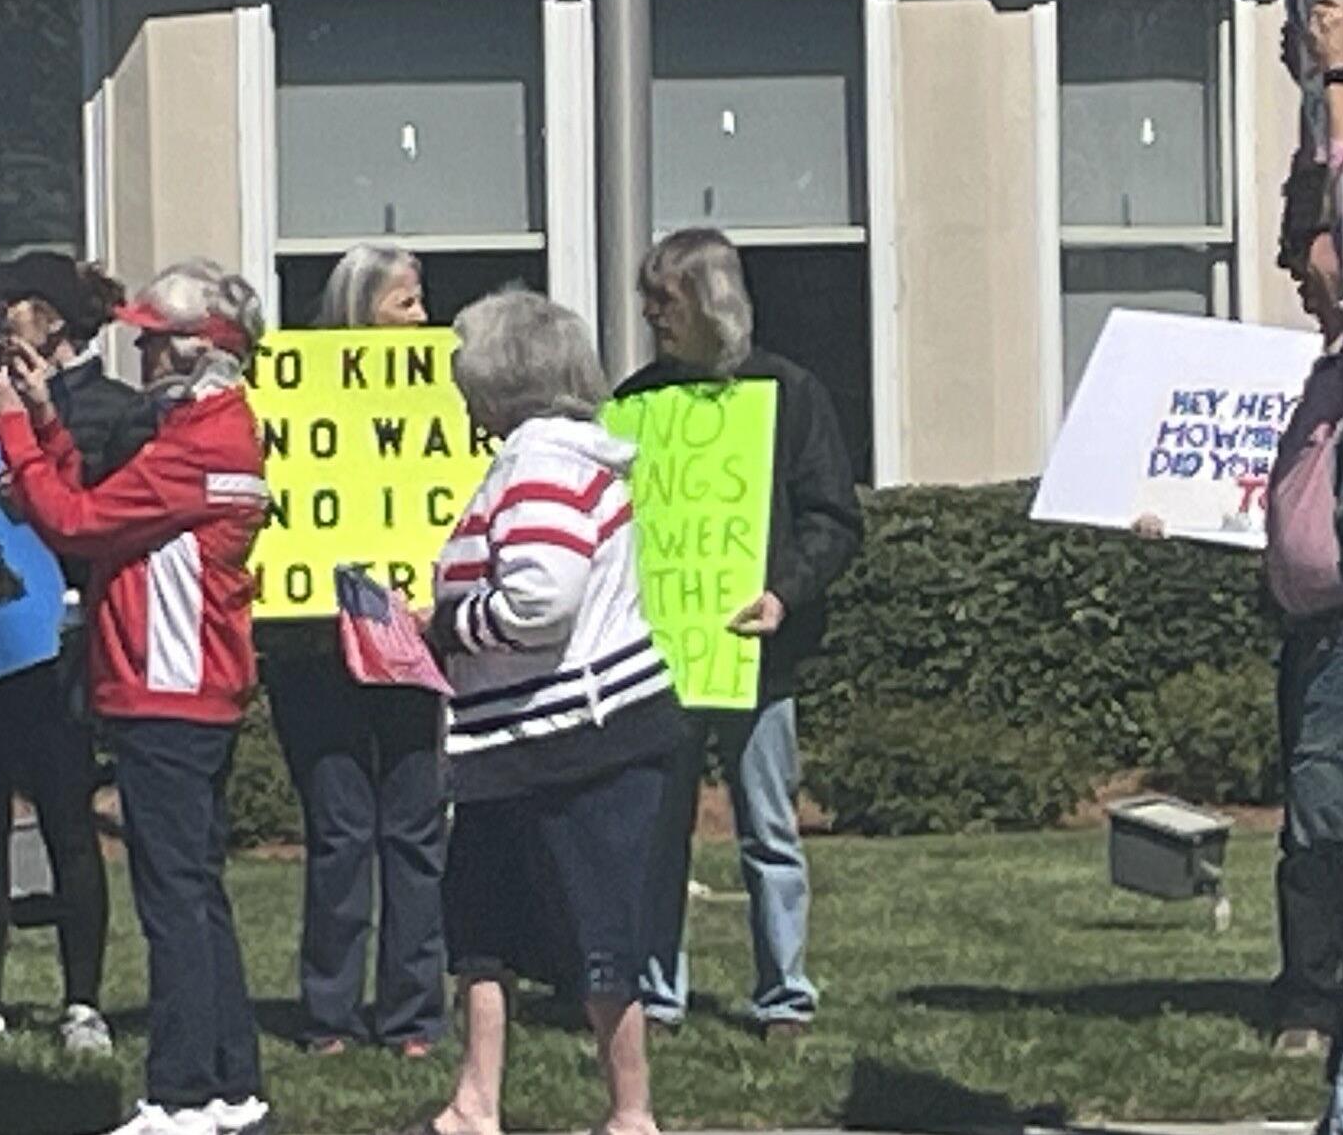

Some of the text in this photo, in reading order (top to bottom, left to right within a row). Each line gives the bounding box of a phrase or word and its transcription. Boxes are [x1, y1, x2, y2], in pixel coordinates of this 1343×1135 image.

[341, 346, 457, 390] KIN
[263, 418, 338, 460] NO
[637, 395, 726, 449] NO
[636, 454, 748, 509] NGS
[1148, 446, 1204, 478] DID
[639, 514, 757, 560] WER
[648, 568, 735, 616] THE
